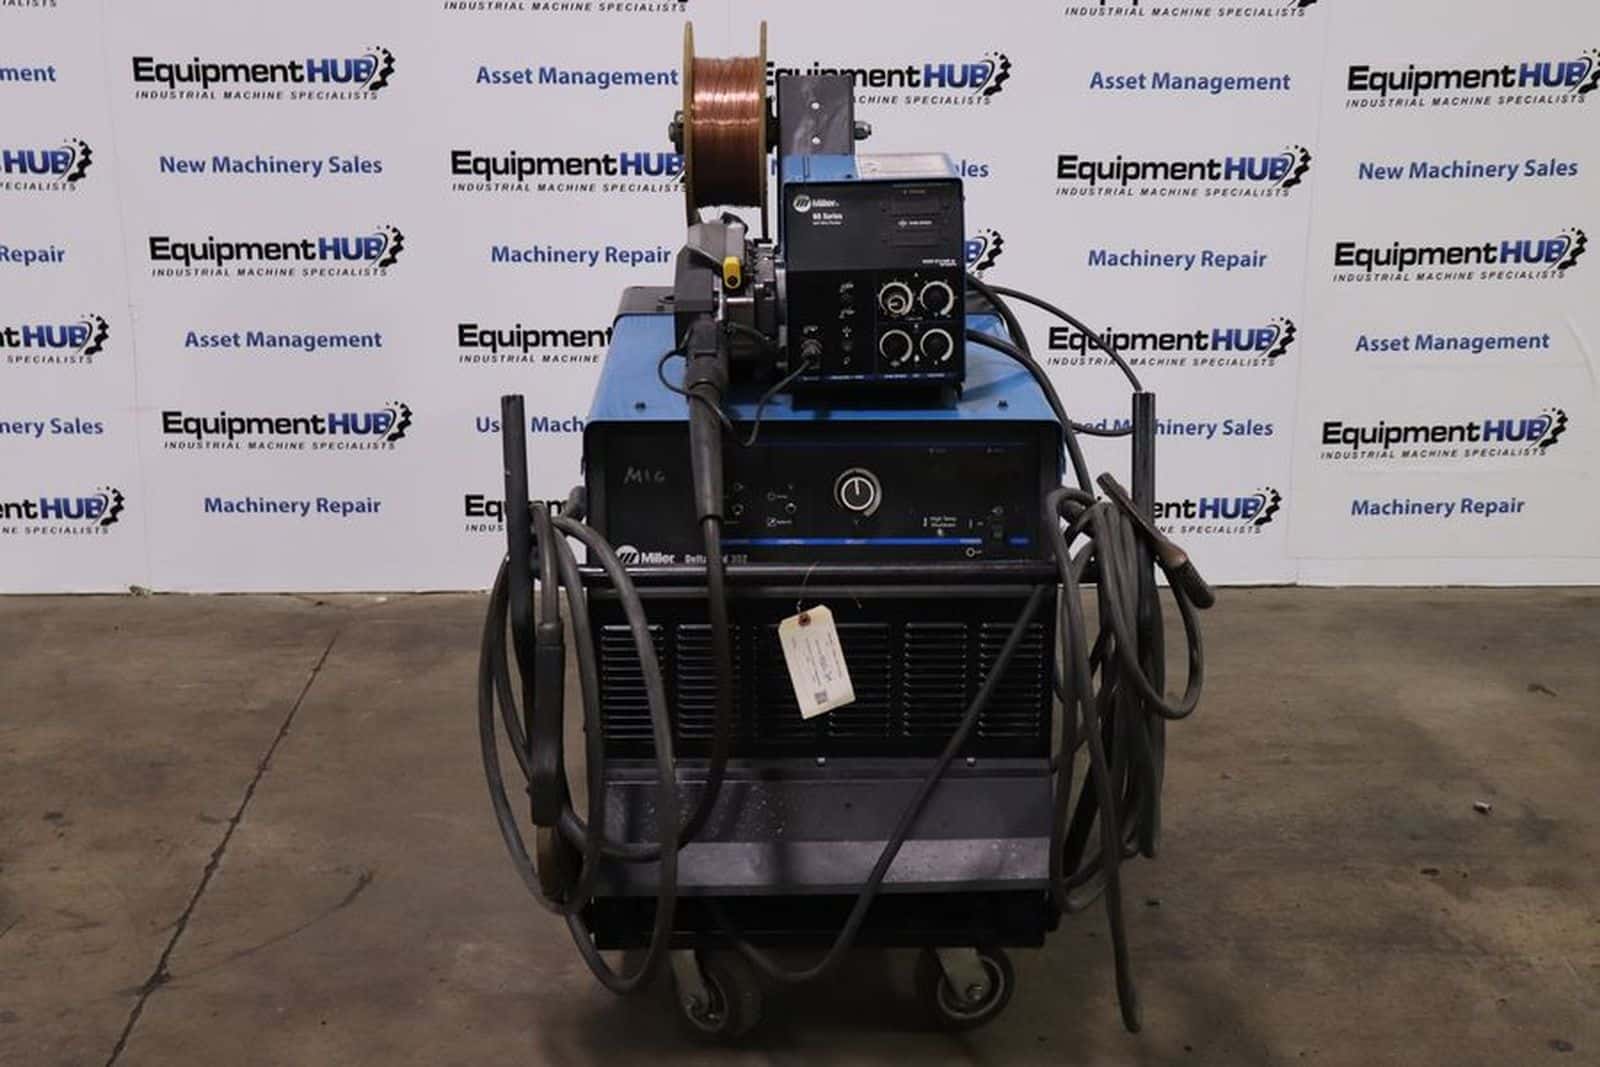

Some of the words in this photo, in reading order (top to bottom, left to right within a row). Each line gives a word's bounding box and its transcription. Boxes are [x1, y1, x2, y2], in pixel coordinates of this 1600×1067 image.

[444, 2, 524, 10] INDUSTRIAL
[532, 2, 591, 11] MACHINE
[599, 2, 687, 12] SPECIALISTS
[1065, 7, 1144, 16] INDUSTRIAL
[1152, 8, 1211, 16] MACHINE
[1219, 7, 1306, 17] SPECIALISTS
[133, 57, 375, 89] EquipmentHUB
[476, 67, 533, 84] Asset
[539, 67, 678, 89] Management
[1090, 72, 1146, 89] Asset
[1152, 72, 1291, 94] Management
[1347, 62, 1586, 96] EquipmentHUB
[136, 91, 214, 99] INDUSTRIAL
[224, 91, 282, 99] MACHINE
[291, 90, 378, 100] SPECIALISTS
[906, 95, 992, 105] SPECIALISTS
[1346, 98, 1424, 107] INDUSTRIAL
[1432, 96, 1491, 106] MACHINE
[1498, 94, 1585, 104] SPECIALISTS
[160, 156, 205, 173] New
[213, 156, 322, 178] Machinery
[329, 156, 382, 173] Sales
[452, 150, 685, 181] EquipmentHUB
[1057, 155, 1289, 186] EquipmentHUB
[1359, 163, 1404, 180] New
[1409, 160, 1519, 181] Machinery
[1524, 159, 1577, 176] Sales
[453, 183, 529, 191] INDUSTRIAL
[538, 184, 594, 192] MACHINE
[1056, 186, 1133, 196] INDUSTRIAL
[1140, 188, 1198, 196] MACHINE
[1205, 186, 1292, 197] SPECIALISTS
[150, 237, 384, 266] EquipmentHUB
[492, 246, 599, 267] Machinery
[606, 246, 671, 267] Repair
[1088, 250, 1195, 271] Machinery
[1201, 250, 1267, 271] Repair
[1334, 240, 1565, 273] EquipmentHUB
[152, 268, 229, 276] INDUSTRIAL
[238, 268, 294, 276] MACHINE
[303, 268, 386, 276] SPECIALISTS
[1333, 273, 1408, 282] INDUSTRIAL
[1416, 272, 1474, 280] MACHINE
[1480, 270, 1564, 280] SPECIALISTS
[185, 332, 240, 347] Asset
[247, 332, 382, 352] Management
[1048, 326, 1275, 356] EquipmentHUB
[1356, 336, 1409, 351] Asset
[1415, 334, 1550, 354] Management
[459, 355, 534, 363] INDUSTRIAL
[542, 355, 598, 363] MACHINE
[1193, 357, 1277, 367] SPECIALISTS
[51, 418, 103, 434] Sales
[162, 410, 392, 440] EquipmentHUB
[1223, 419, 1273, 436] Sales
[1322, 421, 1548, 449] EquipmentHUB
[165, 441, 240, 449] INDUSTRIAL
[313, 441, 395, 450] SPECIALISTS
[1321, 451, 1394, 459] INDUSTRIAL
[1402, 450, 1457, 458] MACHINE
[1464, 447, 1547, 457] SPECIALISTS
[205, 497, 310, 517] Machinery
[316, 498, 381, 517] Repair
[1352, 499, 1455, 518] Machinery
[1461, 498, 1525, 517] Repair
